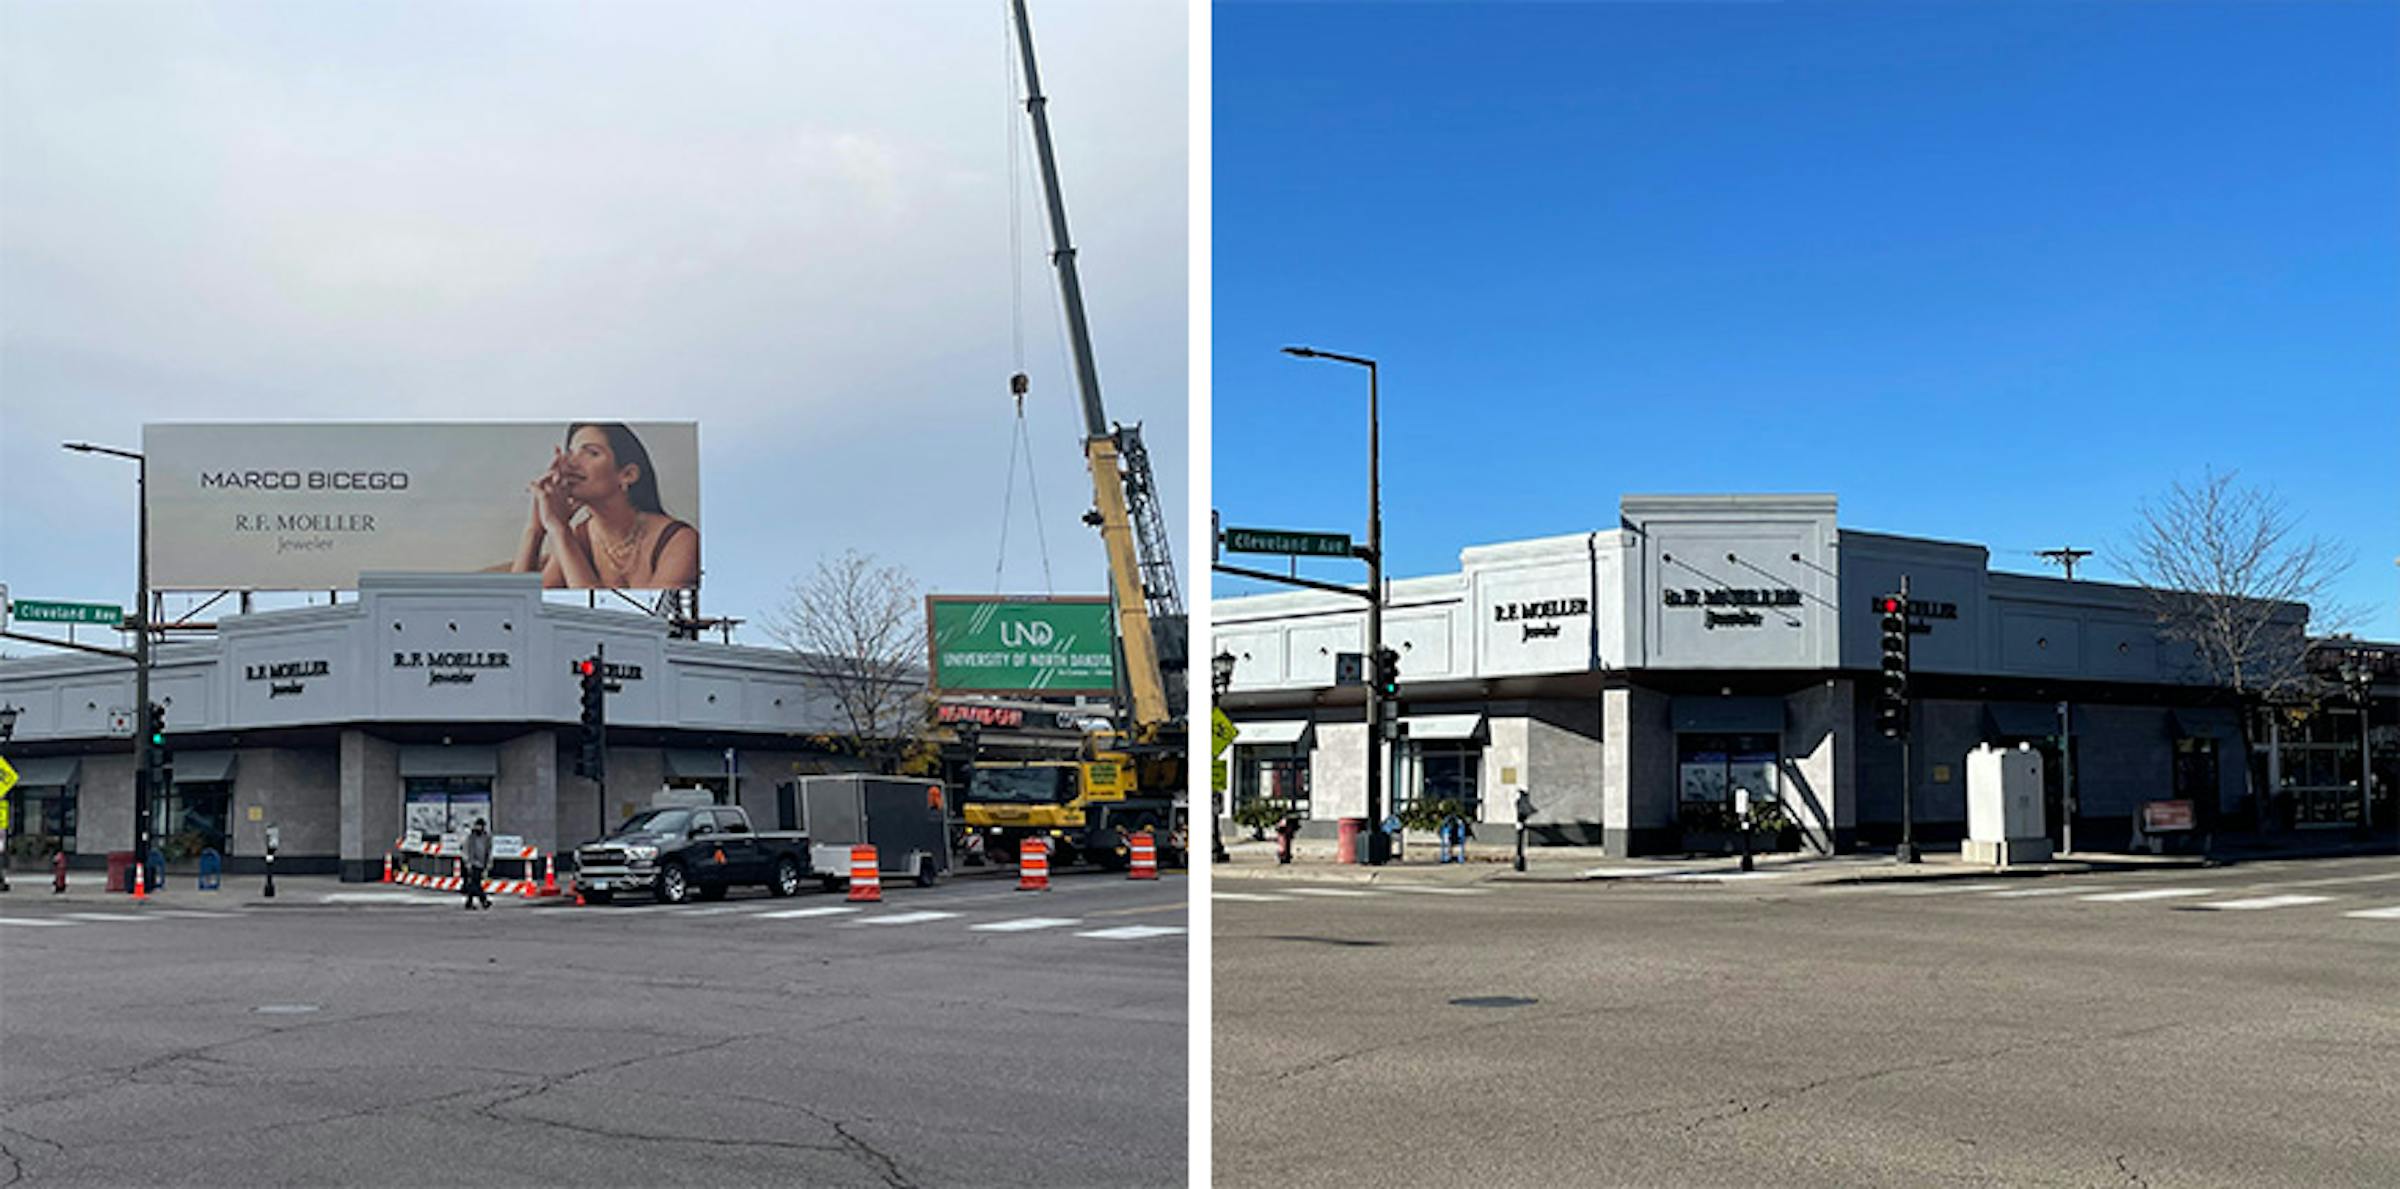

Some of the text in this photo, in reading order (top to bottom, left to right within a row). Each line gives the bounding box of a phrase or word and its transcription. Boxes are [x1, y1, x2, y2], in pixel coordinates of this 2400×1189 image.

[201, 472, 409, 490] MARCO BICEGO
[236, 514, 376, 532] R.F. MOELLER
[276, 535, 334, 554] Jeweler
[1234, 533, 1345, 554] Cleveland Ave
[21, 604, 117, 622] Cleveland Ave
[1522, 598, 1589, 619] MOELLER
[1000, 621, 1054, 647] UND
[393, 652, 510, 668] R.F. MOELLER
[943, 653, 1010, 667] UNIVERSITY
[1012, 653, 1028, 667] OF
[1030, 653, 1068, 667] NORTH
[270, 660, 330, 679] MOELLER
